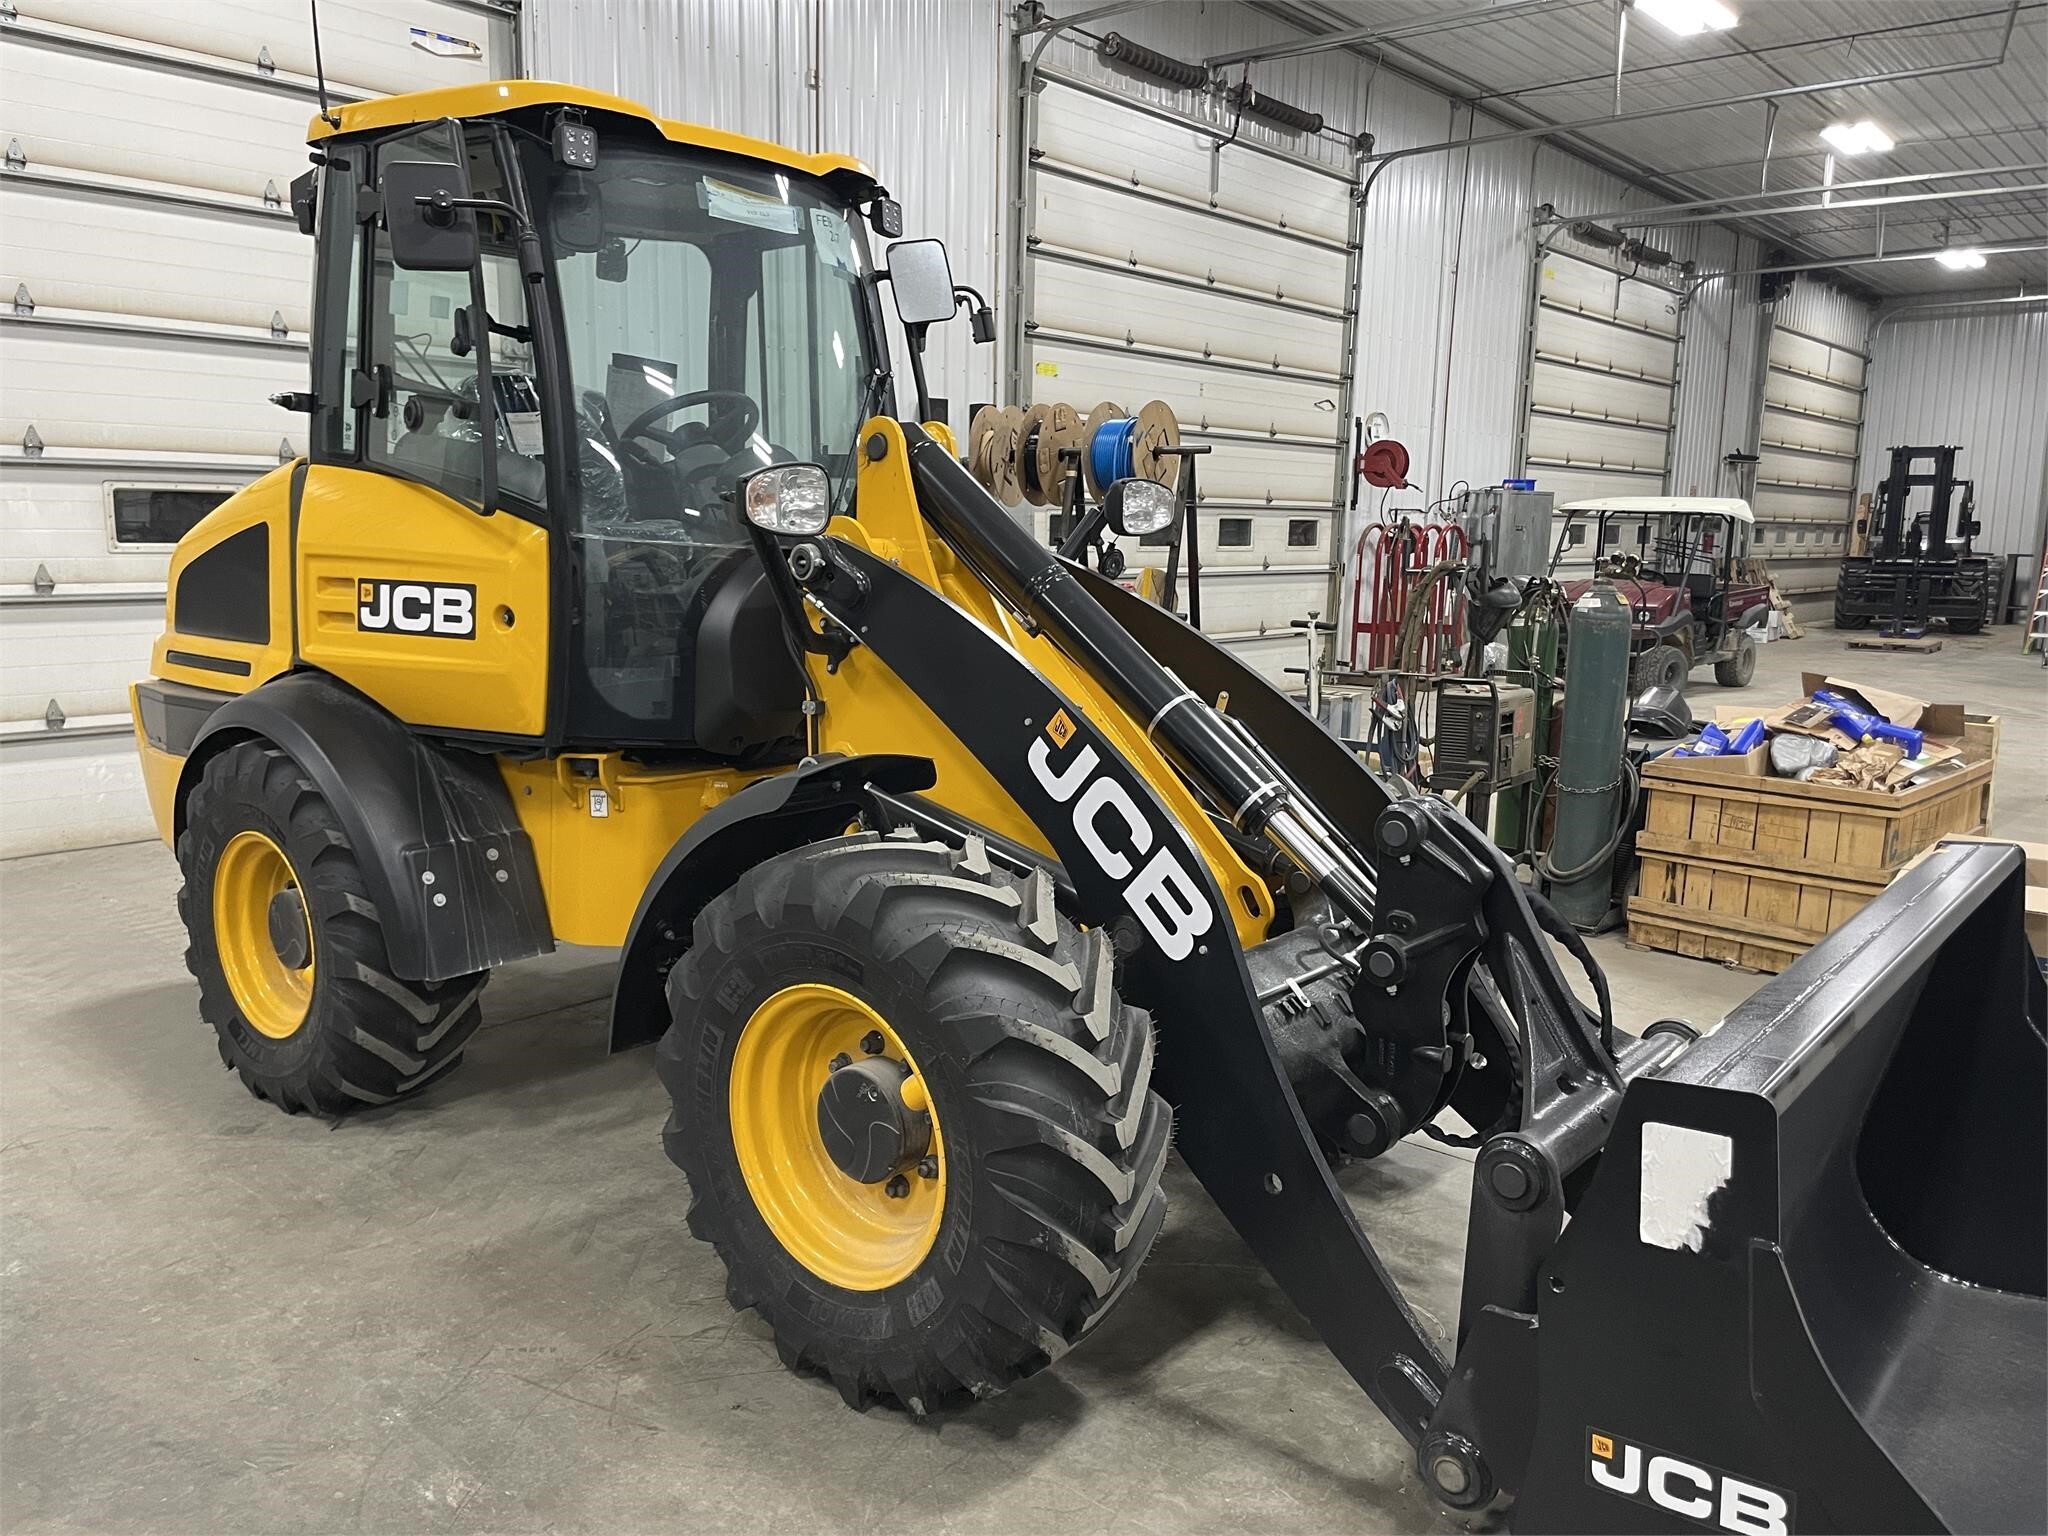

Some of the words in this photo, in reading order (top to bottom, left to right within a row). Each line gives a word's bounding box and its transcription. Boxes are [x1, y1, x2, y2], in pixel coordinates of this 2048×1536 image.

[815, 214, 833, 229] FEB
[360, 584, 473, 635] JCB
[1028, 736, 1214, 962] JCB
[1592, 1445, 1787, 1536] JCB
